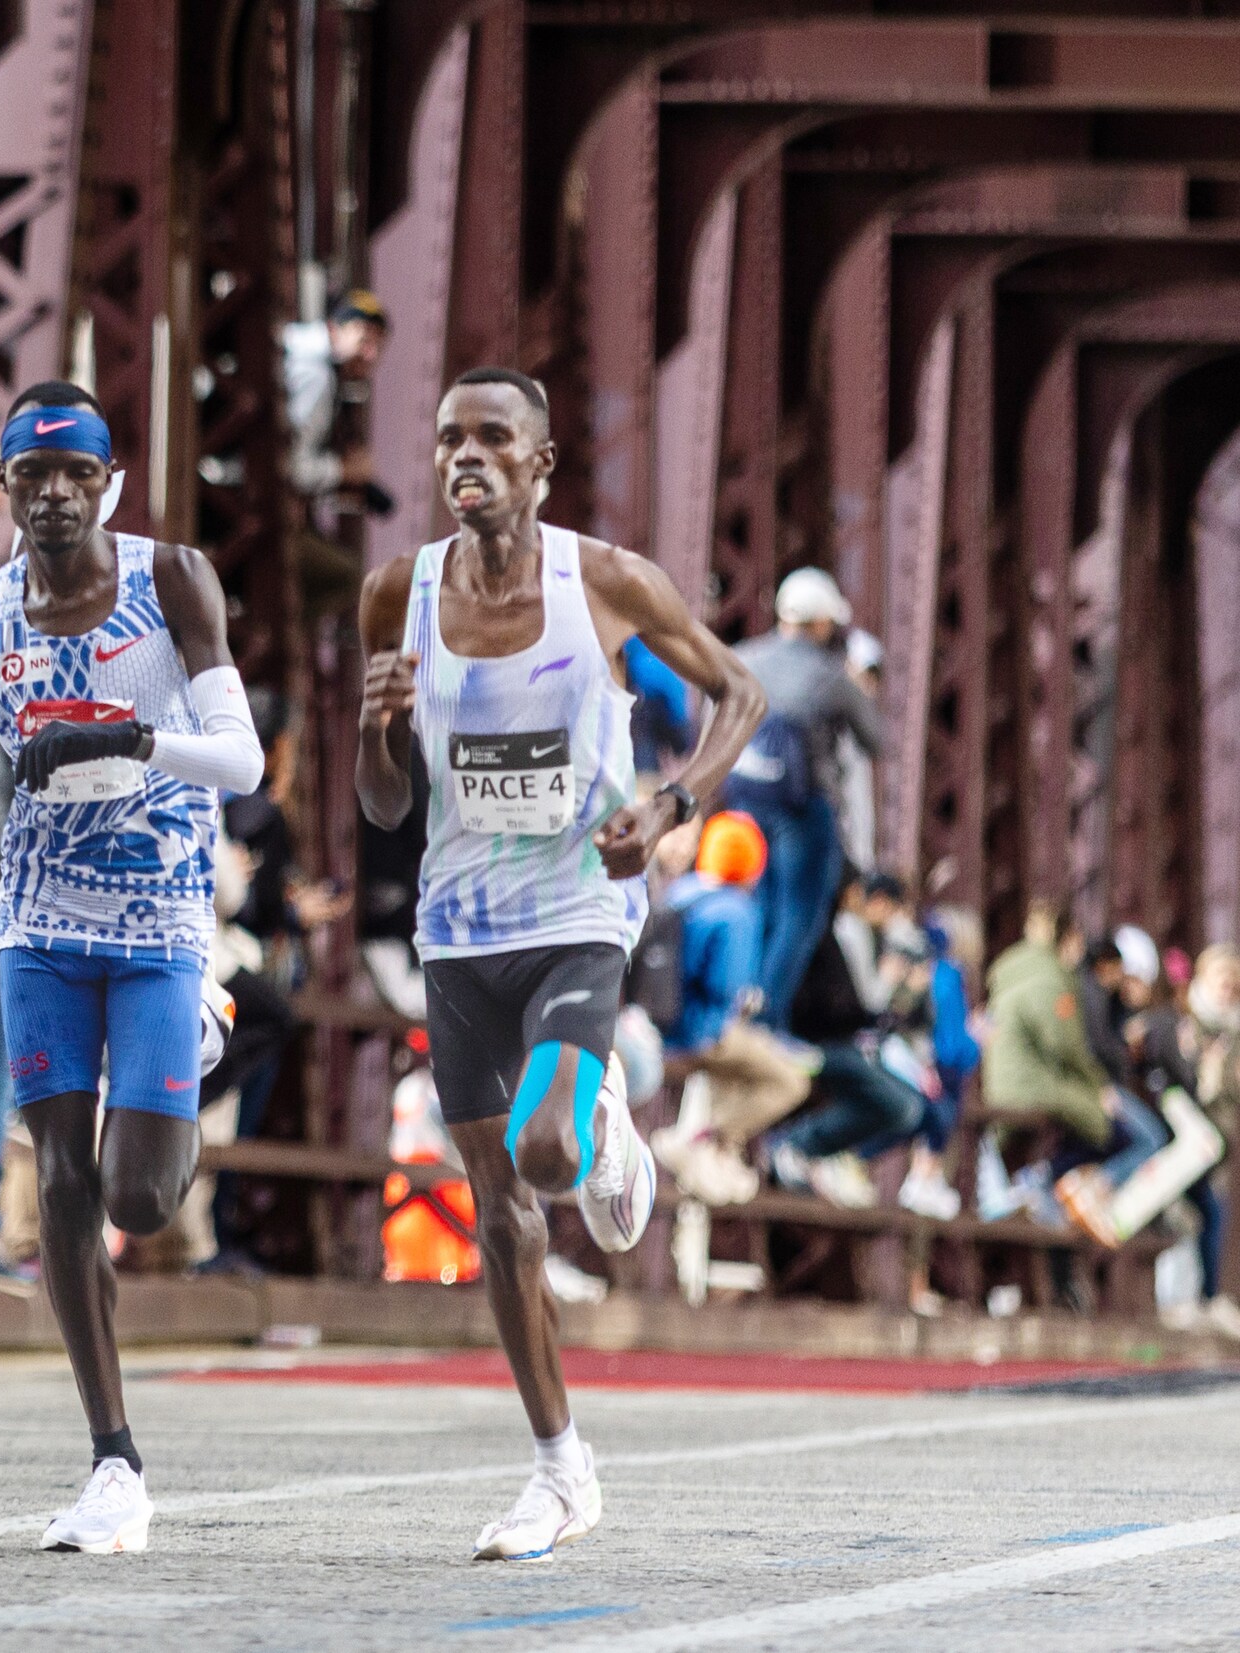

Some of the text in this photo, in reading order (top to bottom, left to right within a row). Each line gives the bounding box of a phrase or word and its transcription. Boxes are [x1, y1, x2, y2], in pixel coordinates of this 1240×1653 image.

[30, 656, 50, 669] NN
[461, 772, 567, 800] PACE 4
